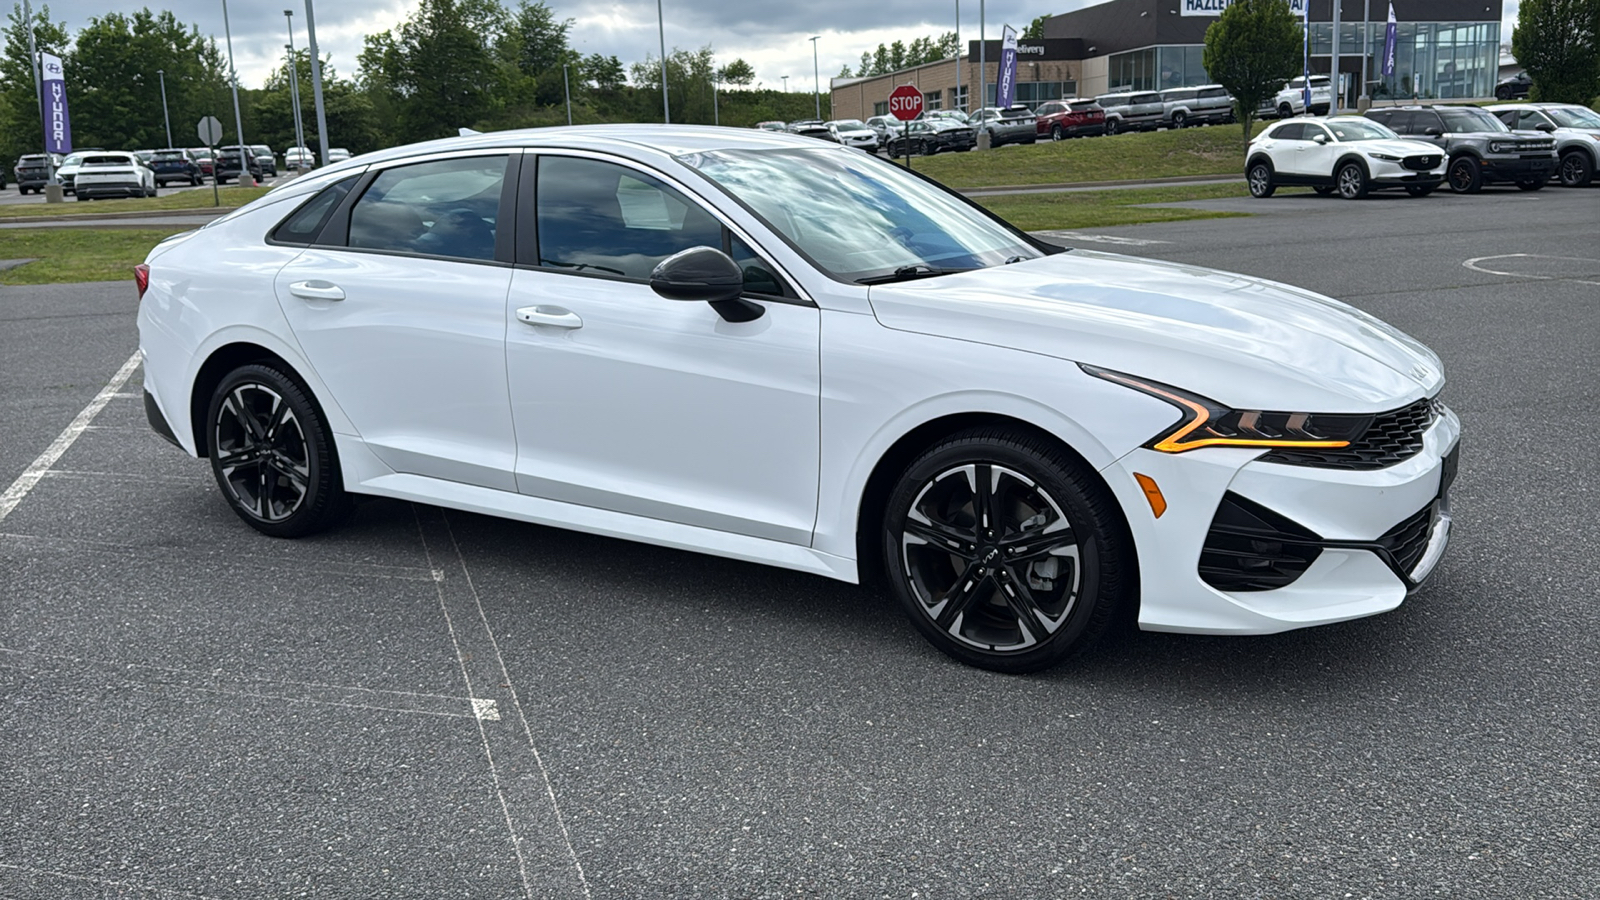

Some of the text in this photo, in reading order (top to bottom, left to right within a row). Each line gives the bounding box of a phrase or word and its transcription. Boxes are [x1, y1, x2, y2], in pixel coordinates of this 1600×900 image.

[1186, 0, 1234, 10] HAZLE
[1016, 44, 1045, 55] elivery
[891, 95, 922, 111] STOP
[52, 82, 64, 150] HYUNDAI
